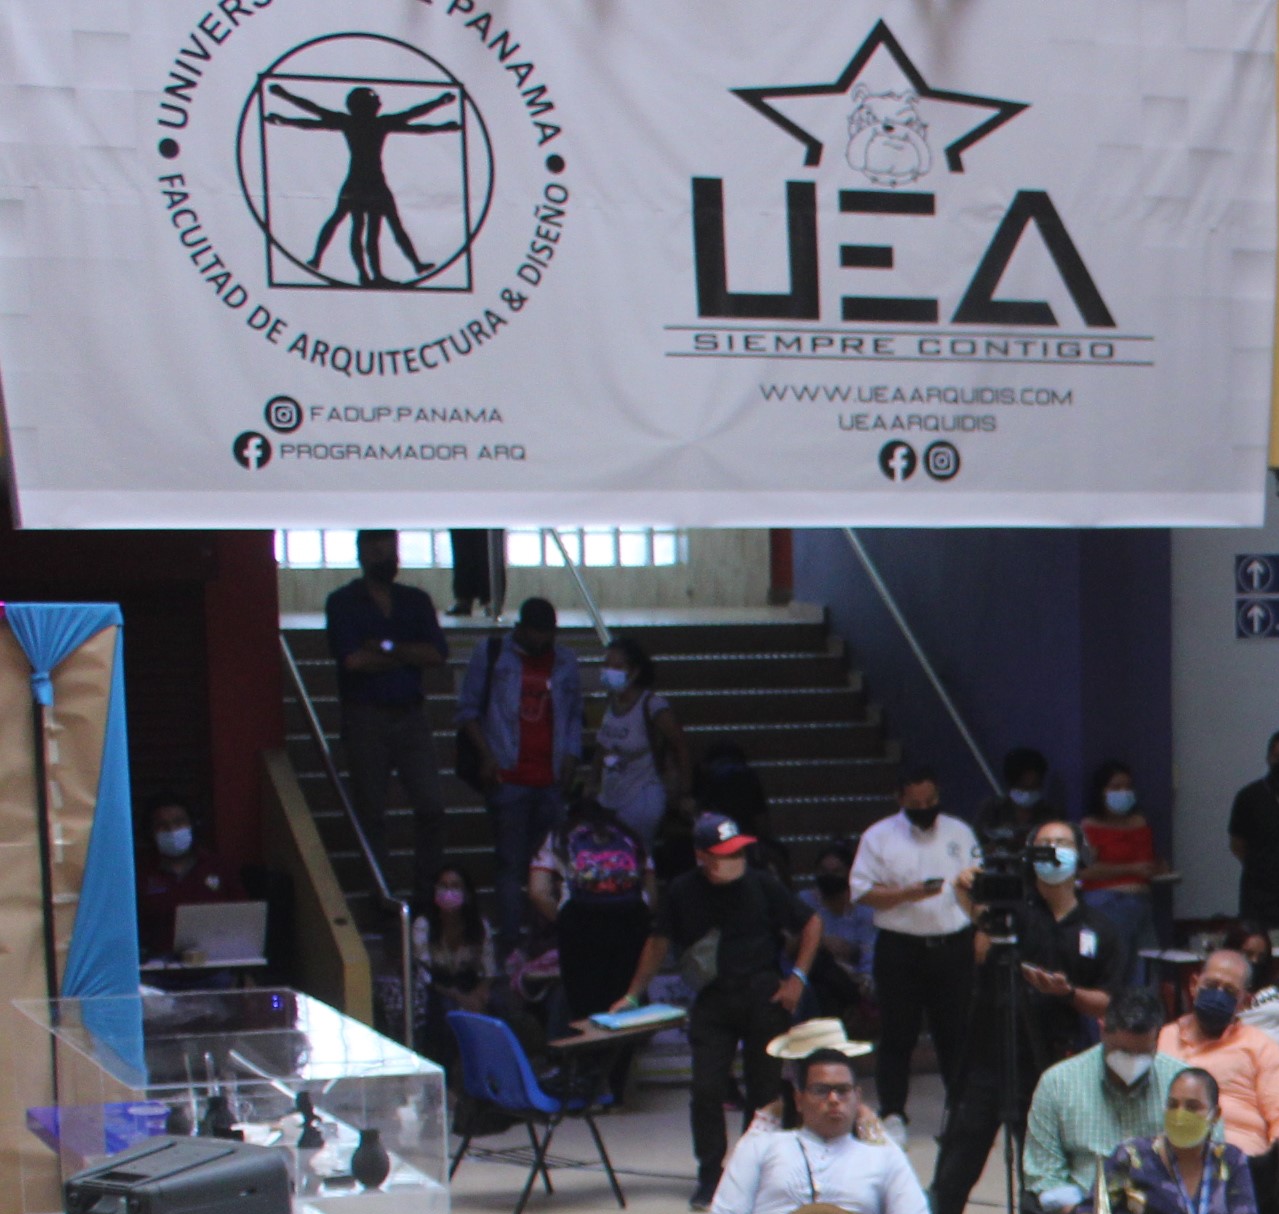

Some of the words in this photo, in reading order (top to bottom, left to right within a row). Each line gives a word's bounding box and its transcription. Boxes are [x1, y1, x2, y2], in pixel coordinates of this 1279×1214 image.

[691, 176, 1117, 328] UEA
[158, 173, 249, 309] FACULTAD
[246, 305, 288, 345] DE
[286, 308, 508, 378] ARQUITECTURA
[500, 287, 529, 313] &
[516, 182, 569, 287] DISEÑO
[693, 332, 896, 356] SIEMPRE
[917, 338, 1116, 359] CONTIGO
[759, 384, 1074, 406] WWW.UEAARQUIDIS.COM
[837, 413, 997, 433] UEAARQUIDIS
[279, 443, 469, 461] PROGRAMADOR
[477, 444, 527, 461] ARQ
